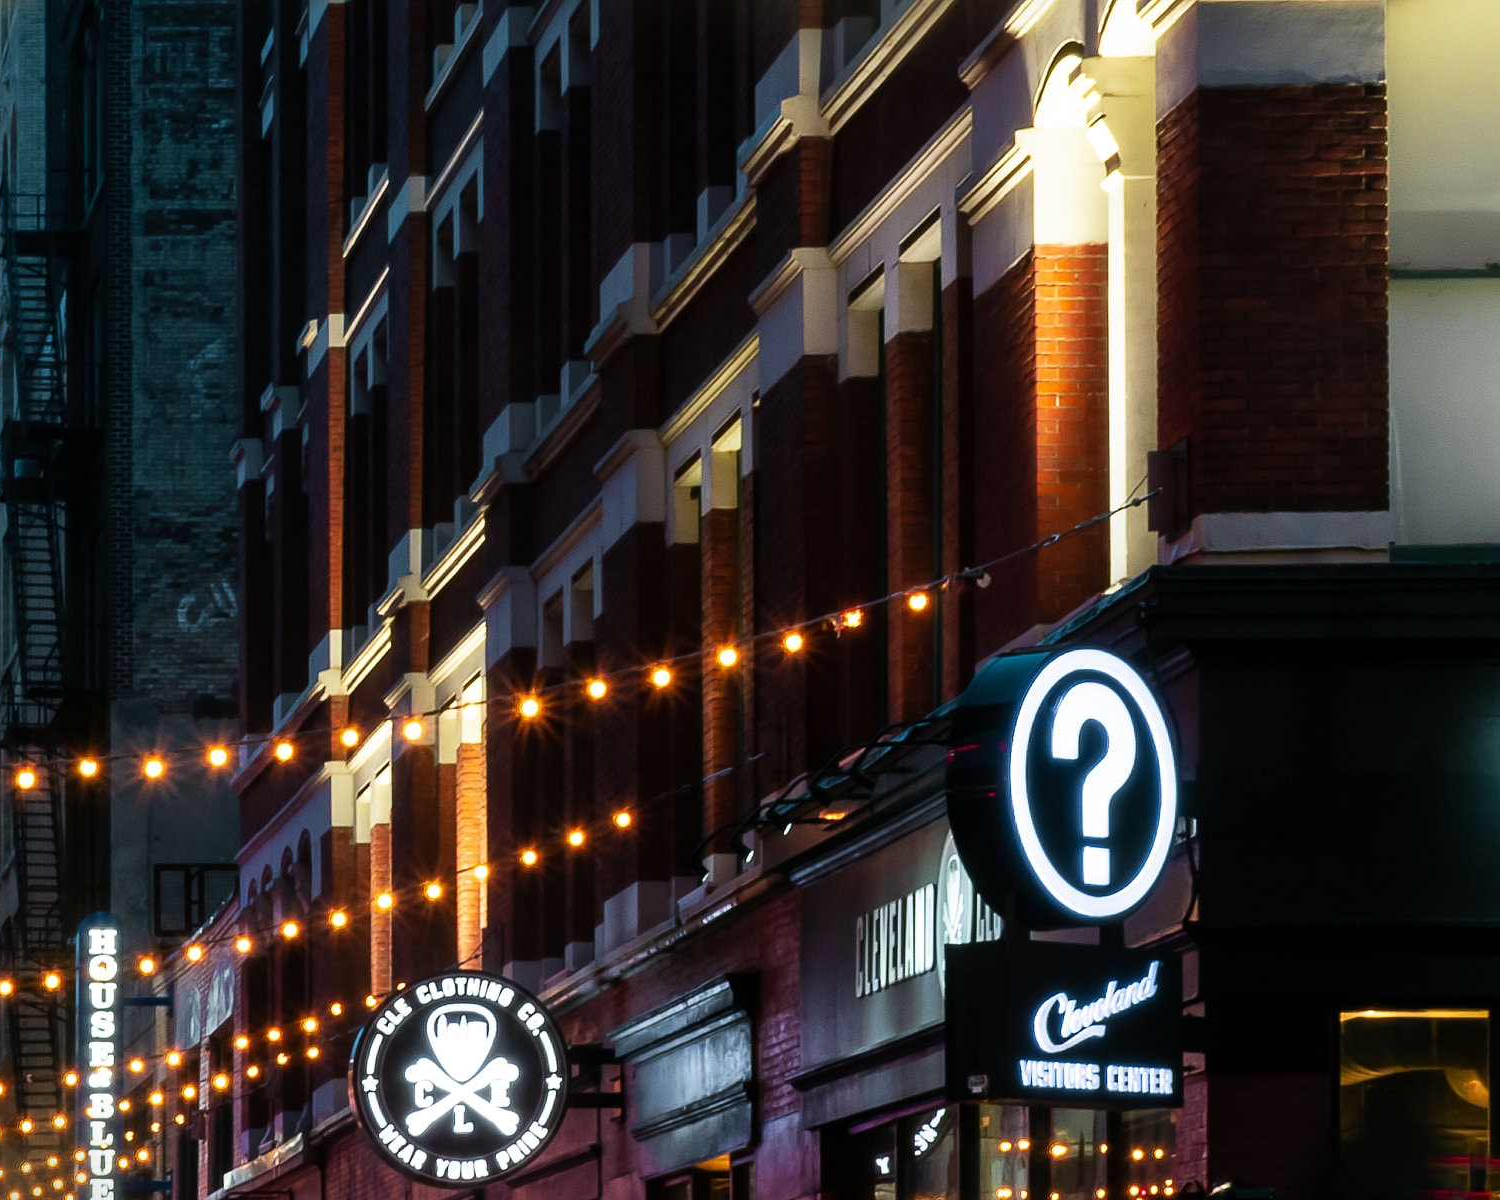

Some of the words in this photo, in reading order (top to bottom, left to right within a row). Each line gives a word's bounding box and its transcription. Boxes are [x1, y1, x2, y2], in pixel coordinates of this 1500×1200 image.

[855, 883, 934, 998] CLEVELAND
[87, 928, 118, 1067] HOUSE
[376, 997, 413, 1036] CLE
[415, 977, 515, 1008] CLOTHING
[1033, 961, 1160, 1054] Cleveland
[1019, 1059, 1100, 1091] VISITORS
[1106, 1064, 1173, 1095] CENTER
[378, 1123, 428, 1170] WEAR
[435, 1157, 490, 1180] YOUR
[495, 1120, 549, 1171] PRIDE
